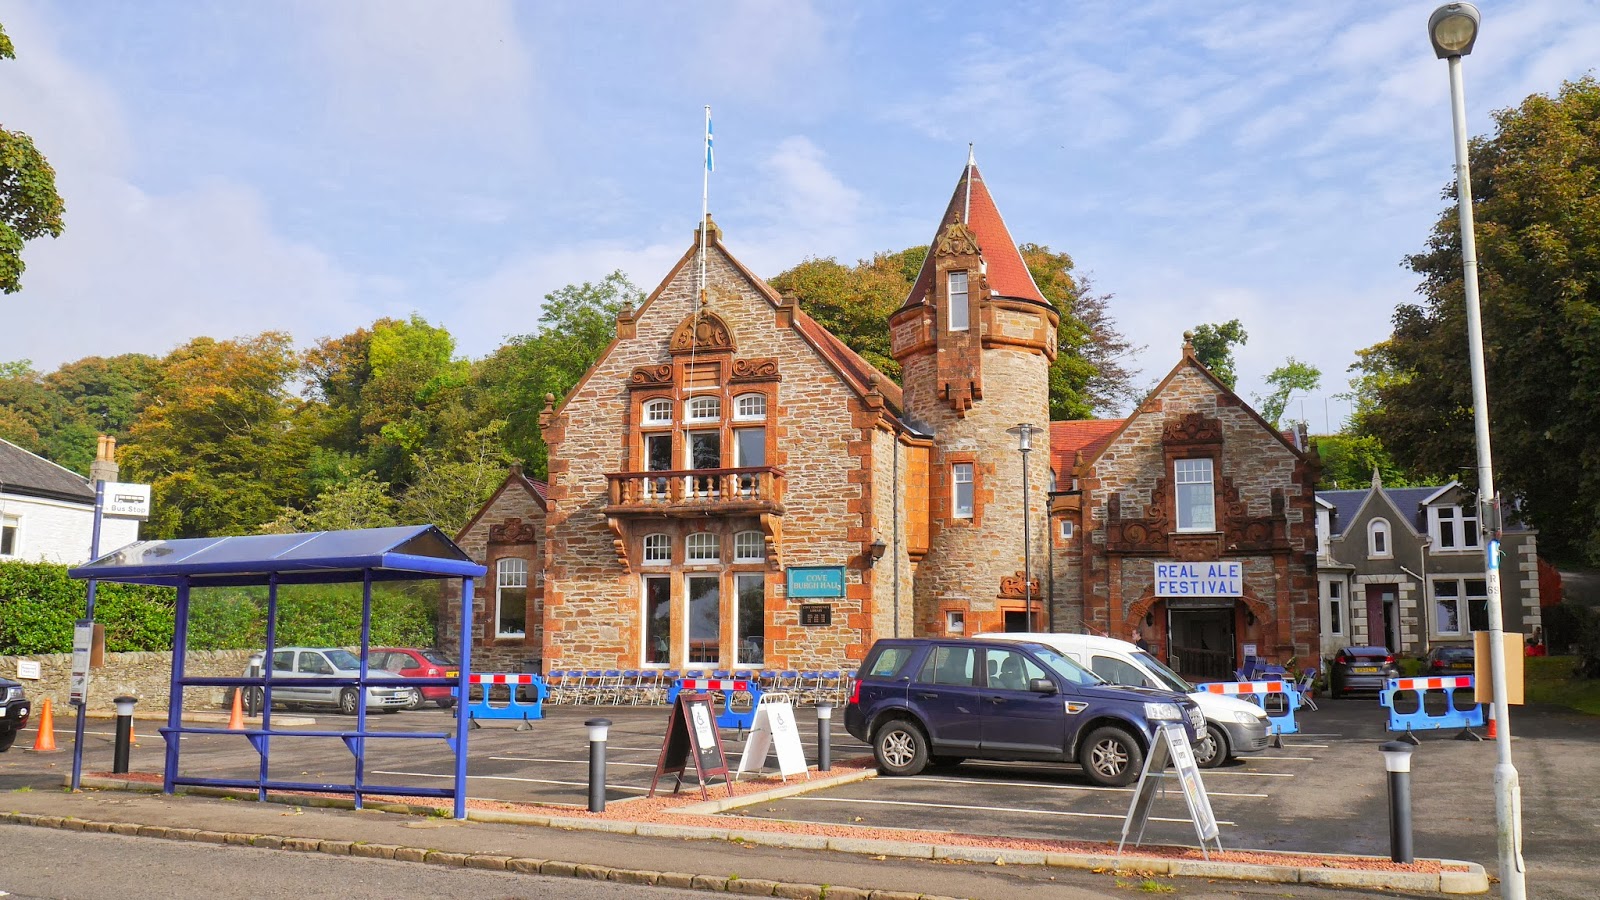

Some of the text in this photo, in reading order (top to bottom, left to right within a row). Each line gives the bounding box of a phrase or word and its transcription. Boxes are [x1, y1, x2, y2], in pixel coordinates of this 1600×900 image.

[111, 504, 146, 514] Bus Stop
[1158, 564, 1239, 578] REAL ALE
[1159, 581, 1239, 594] FESTIVAL
